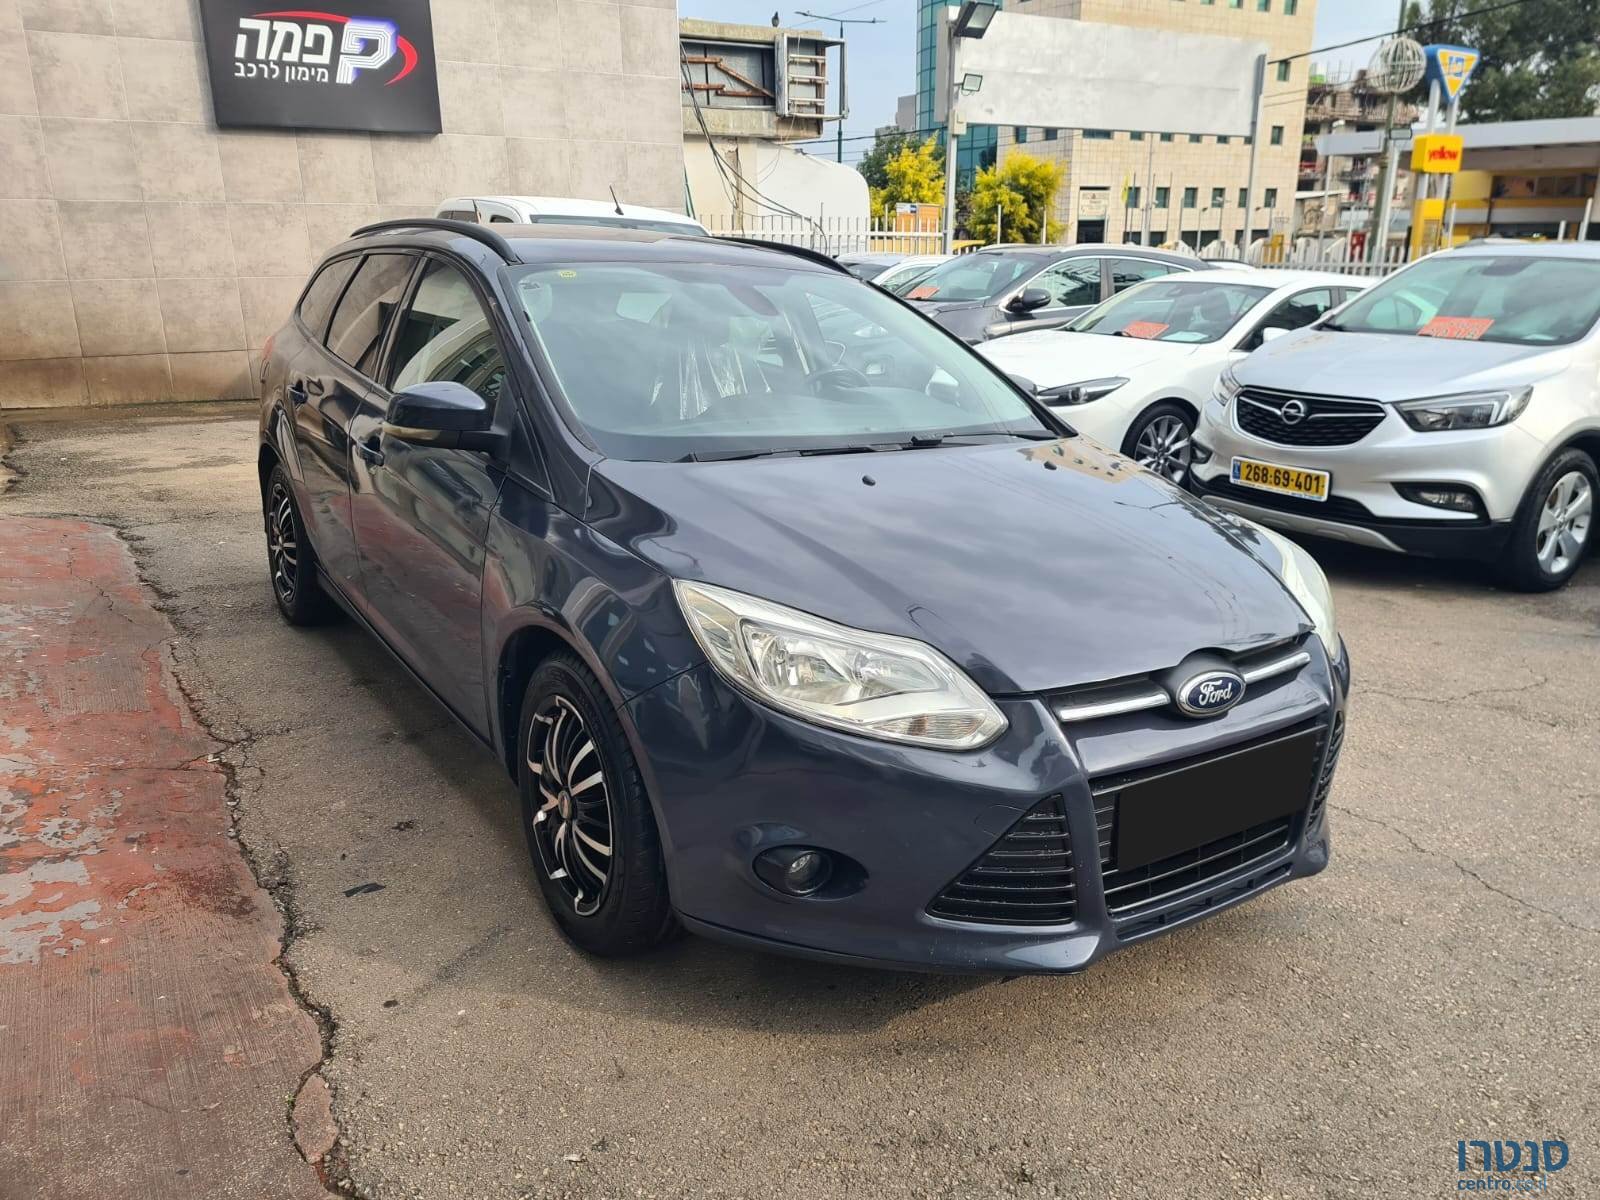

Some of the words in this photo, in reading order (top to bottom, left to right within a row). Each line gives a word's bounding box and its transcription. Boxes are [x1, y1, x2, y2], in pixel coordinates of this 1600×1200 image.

[235, 18, 333, 64] פמה
[234, 61, 280, 79] לרכב
[285, 64, 329, 83] מימון
[1199, 680, 1232, 706] Ford
